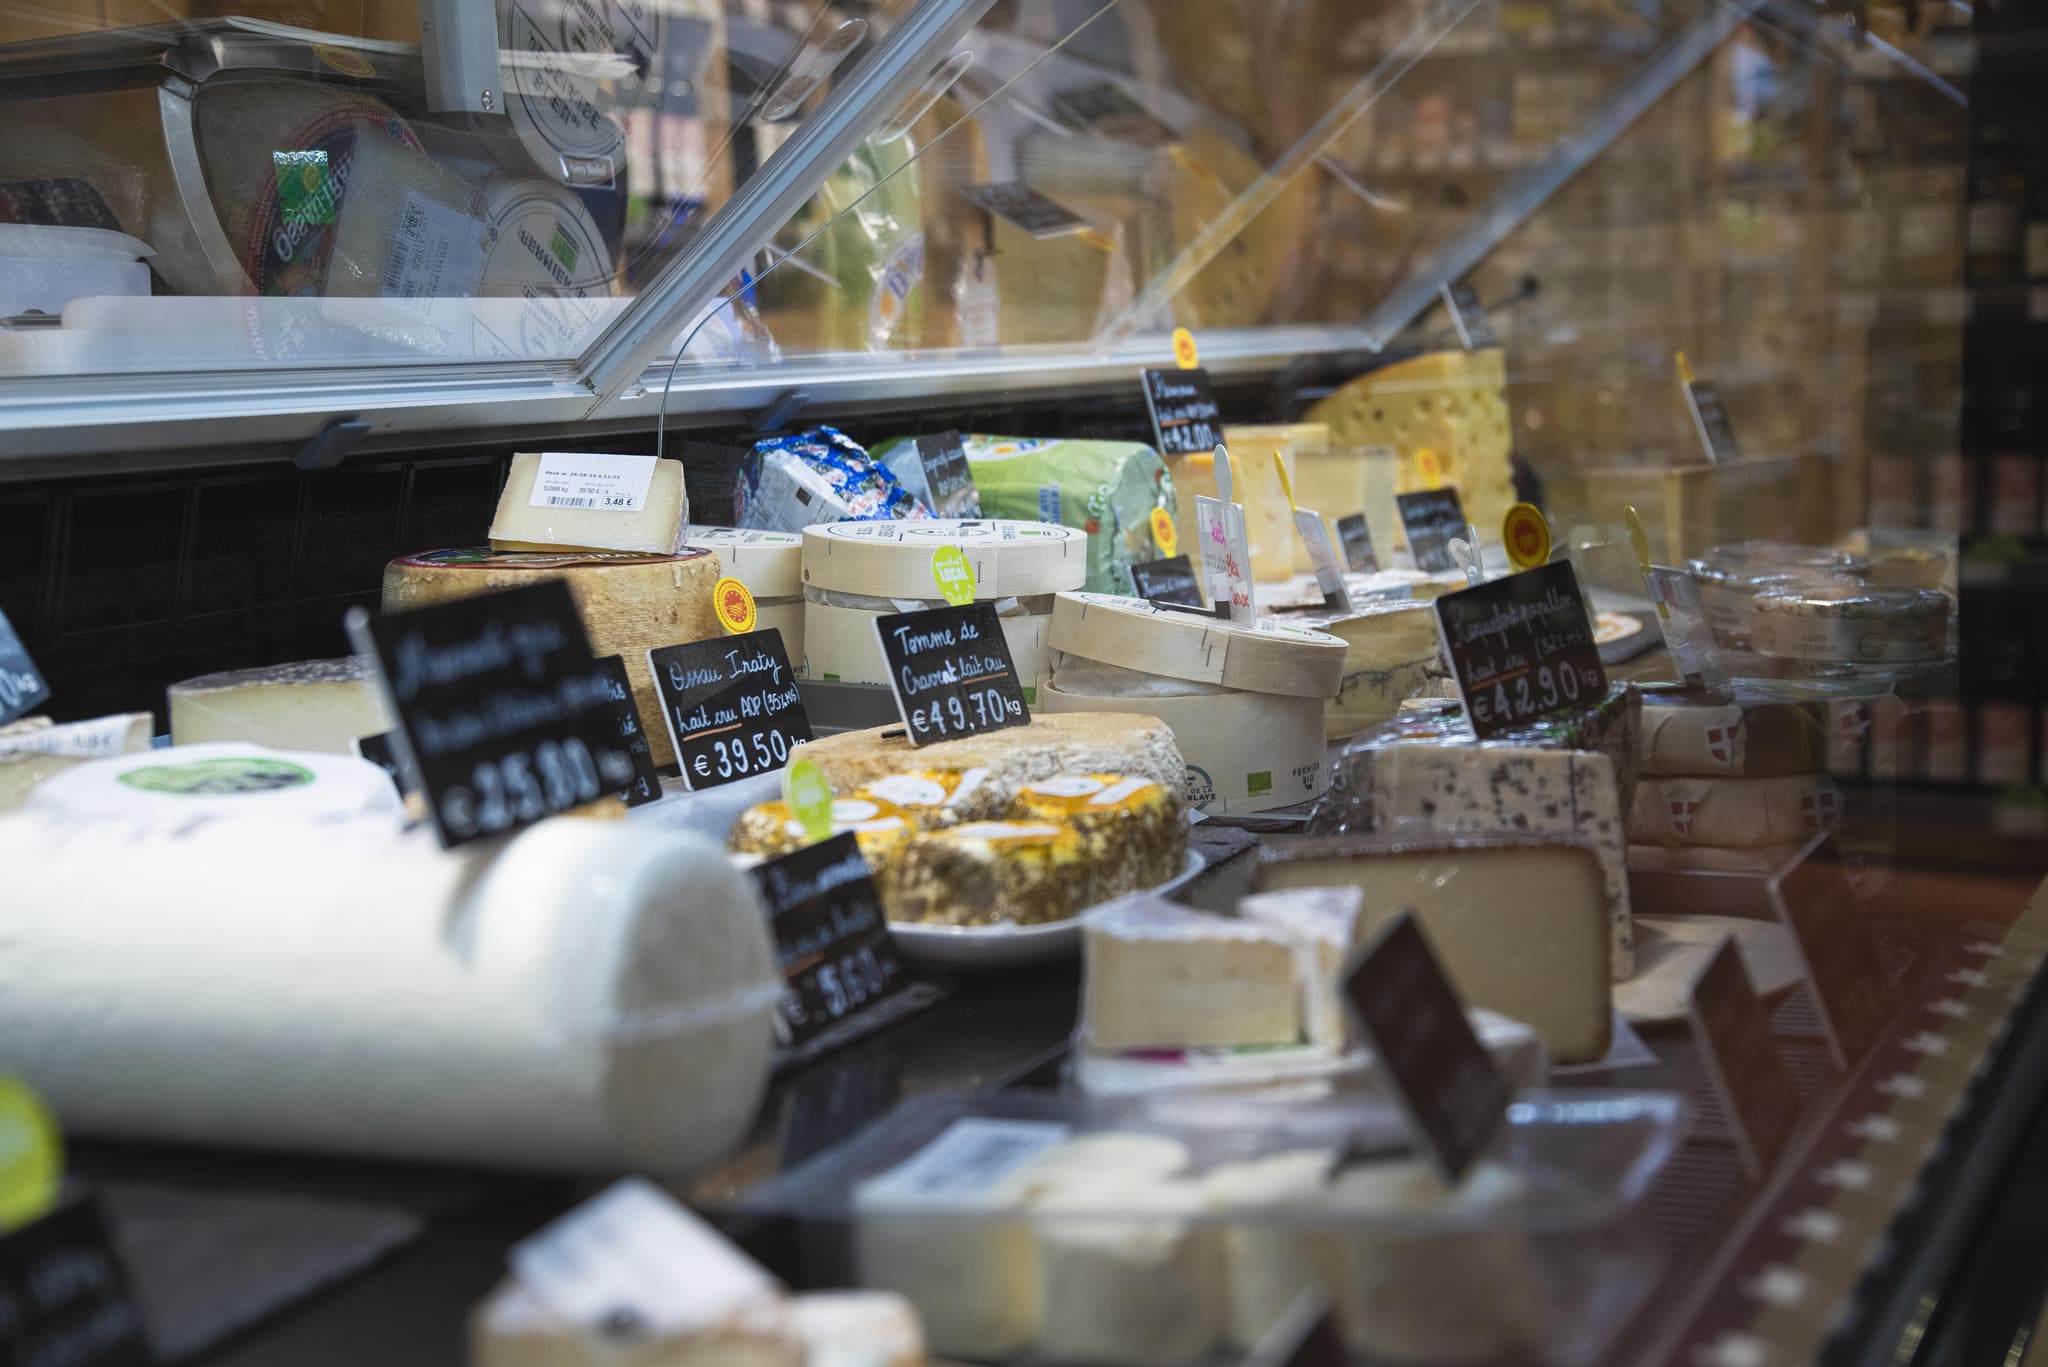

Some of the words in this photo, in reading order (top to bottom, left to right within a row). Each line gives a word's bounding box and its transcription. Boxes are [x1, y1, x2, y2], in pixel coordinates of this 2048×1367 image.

[604, 498, 624, 506] 3,48
[626, 498, 633, 506] €
[939, 566, 969, 582] LOCAL
[893, 626, 956, 656] Tomme
[960, 620, 979, 641] de
[669, 660, 723, 691] Ossau
[724, 650, 783, 686] Iraty
[740, 695, 761, 717] AOP
[1003, 696, 1022, 716] kg
